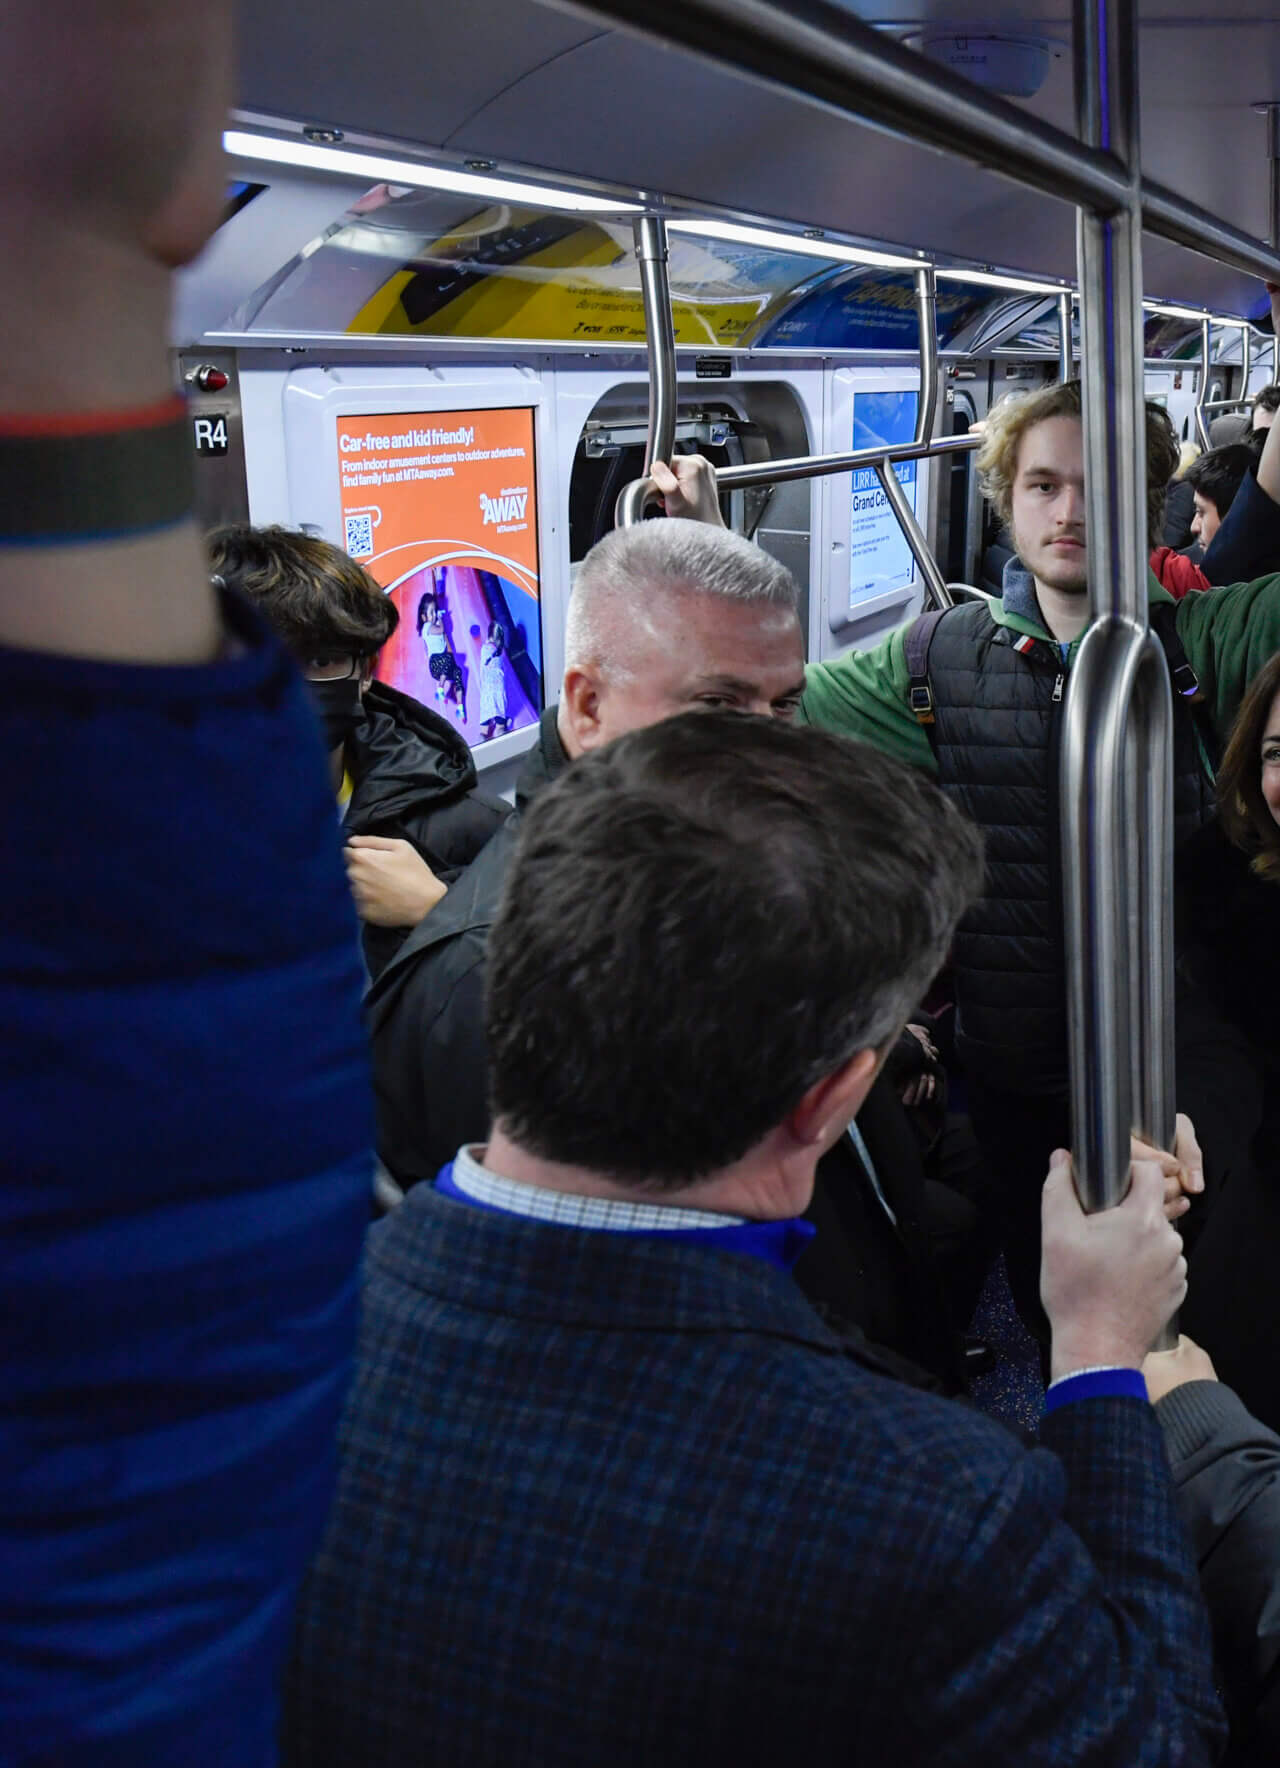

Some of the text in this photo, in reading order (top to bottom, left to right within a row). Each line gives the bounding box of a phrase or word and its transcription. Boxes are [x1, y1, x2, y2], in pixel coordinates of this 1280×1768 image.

[194, 419, 228, 449] R4
[340, 427, 474, 452] Car-free and kid friendly!
[341, 459, 364, 473] From
[363, 456, 388, 471] indoor
[389, 453, 432, 469] amusement
[431, 451, 457, 465] centers
[457, 451, 465, 462] to
[465, 448, 490, 461] outdoor
[342, 474, 358, 488] find
[359, 471, 383, 487] family
[382, 471, 395, 483] fun
[395, 470, 403, 482] at
[853, 471, 870, 490] LIRR
[483, 494, 528, 526] AWAY
[852, 491, 875, 512] Grand
